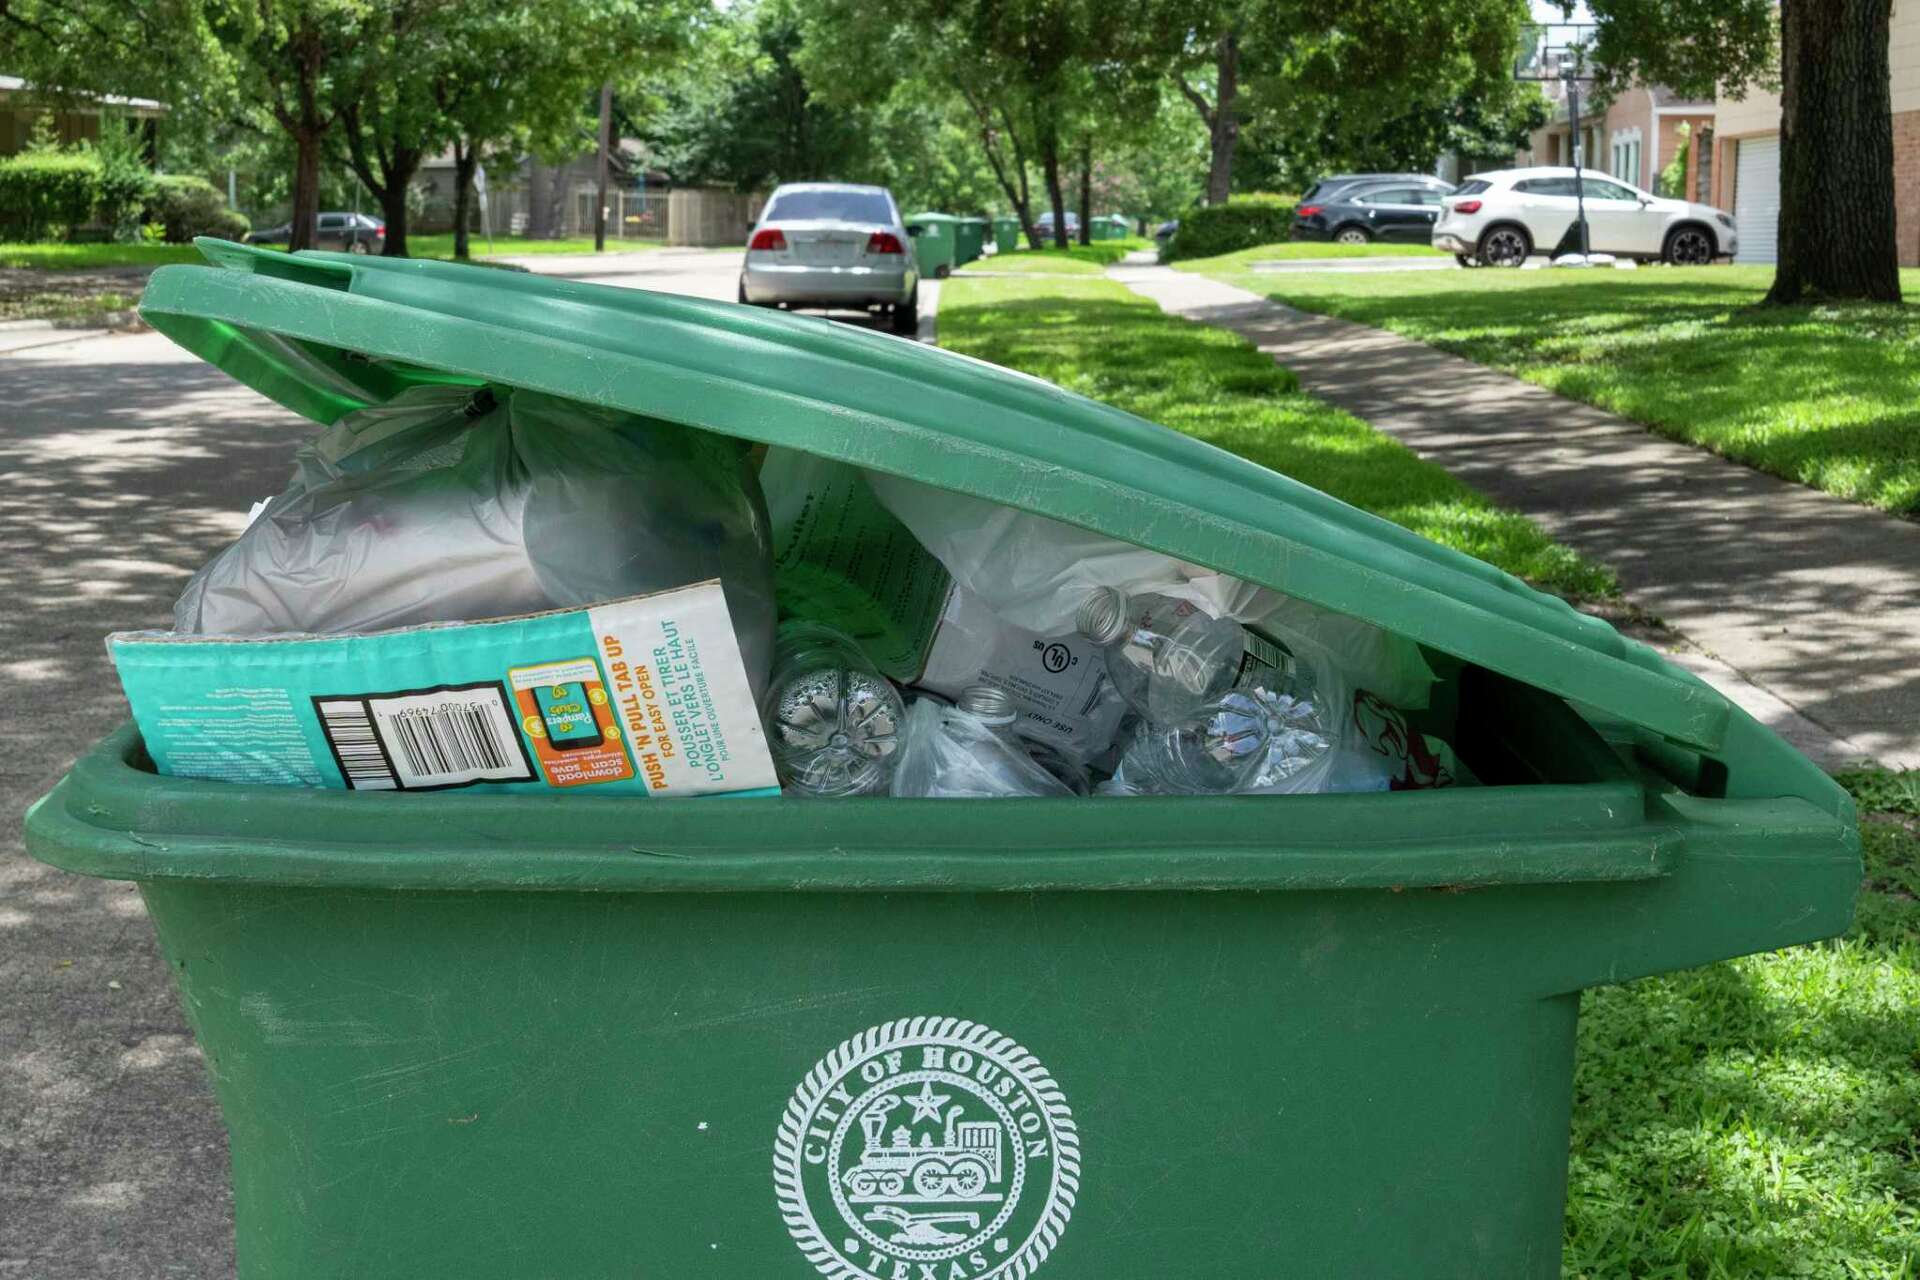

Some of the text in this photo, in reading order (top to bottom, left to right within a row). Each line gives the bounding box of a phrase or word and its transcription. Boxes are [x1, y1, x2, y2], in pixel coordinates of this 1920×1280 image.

[1033, 640, 1046, 652] US
[546, 712, 593, 724] Pampers
[604, 635, 669, 790] PUSH 'N PULL TAB UP
[634, 664, 676, 758] FOR EASY OPEN
[652, 645, 704, 768] POUSSER ET TIRER
[661, 620, 725, 781] L'ONGLET VERS LE HAUT
[684, 638, 732, 761] POUR UNE OUVERTURE FACILE
[1028, 711, 1073, 734] USE ONLY
[550, 758, 623, 774] scan save
[556, 766, 623, 783] download
[805, 1046, 1049, 1165] CITY OF HOUSTON
[867, 1251, 988, 1280] TEXAS
